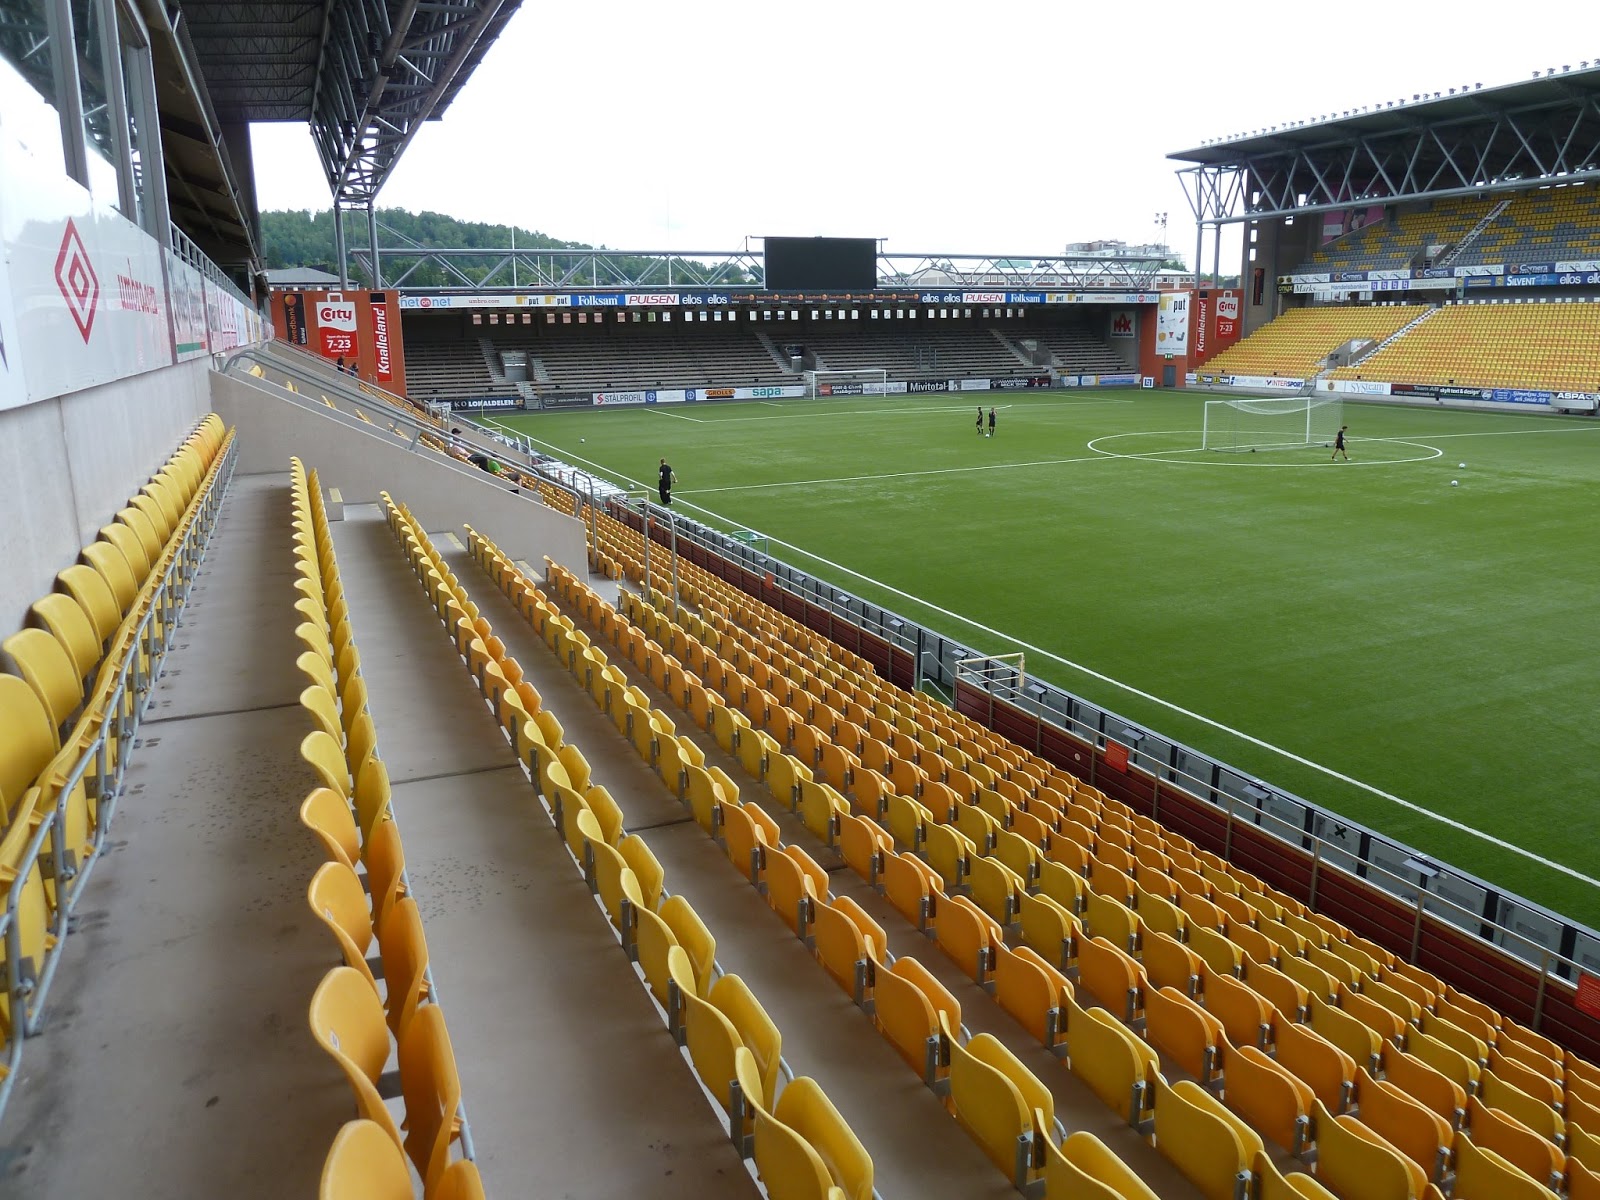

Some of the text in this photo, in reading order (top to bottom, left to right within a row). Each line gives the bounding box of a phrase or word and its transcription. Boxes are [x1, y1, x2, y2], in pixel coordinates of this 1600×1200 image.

[1560, 274, 1581, 284] ellos
[578, 295, 618, 306] Folksam
[629, 296, 675, 304] PULSEN
[682, 294, 727, 304] ellos ellos
[922, 294, 960, 303] ellos ellos
[1011, 294, 1040, 303] Folksam
[321, 308, 352, 322] City
[288, 307, 298, 343] Swedbank
[1197, 302, 1207, 352] Knalleland
[327, 340, 351, 348] 7-23
[373, 307, 389, 374] Knalleland
[910, 382, 946, 391] Mivitotal
[605, 394, 642, 402] STÅLPROFIL
